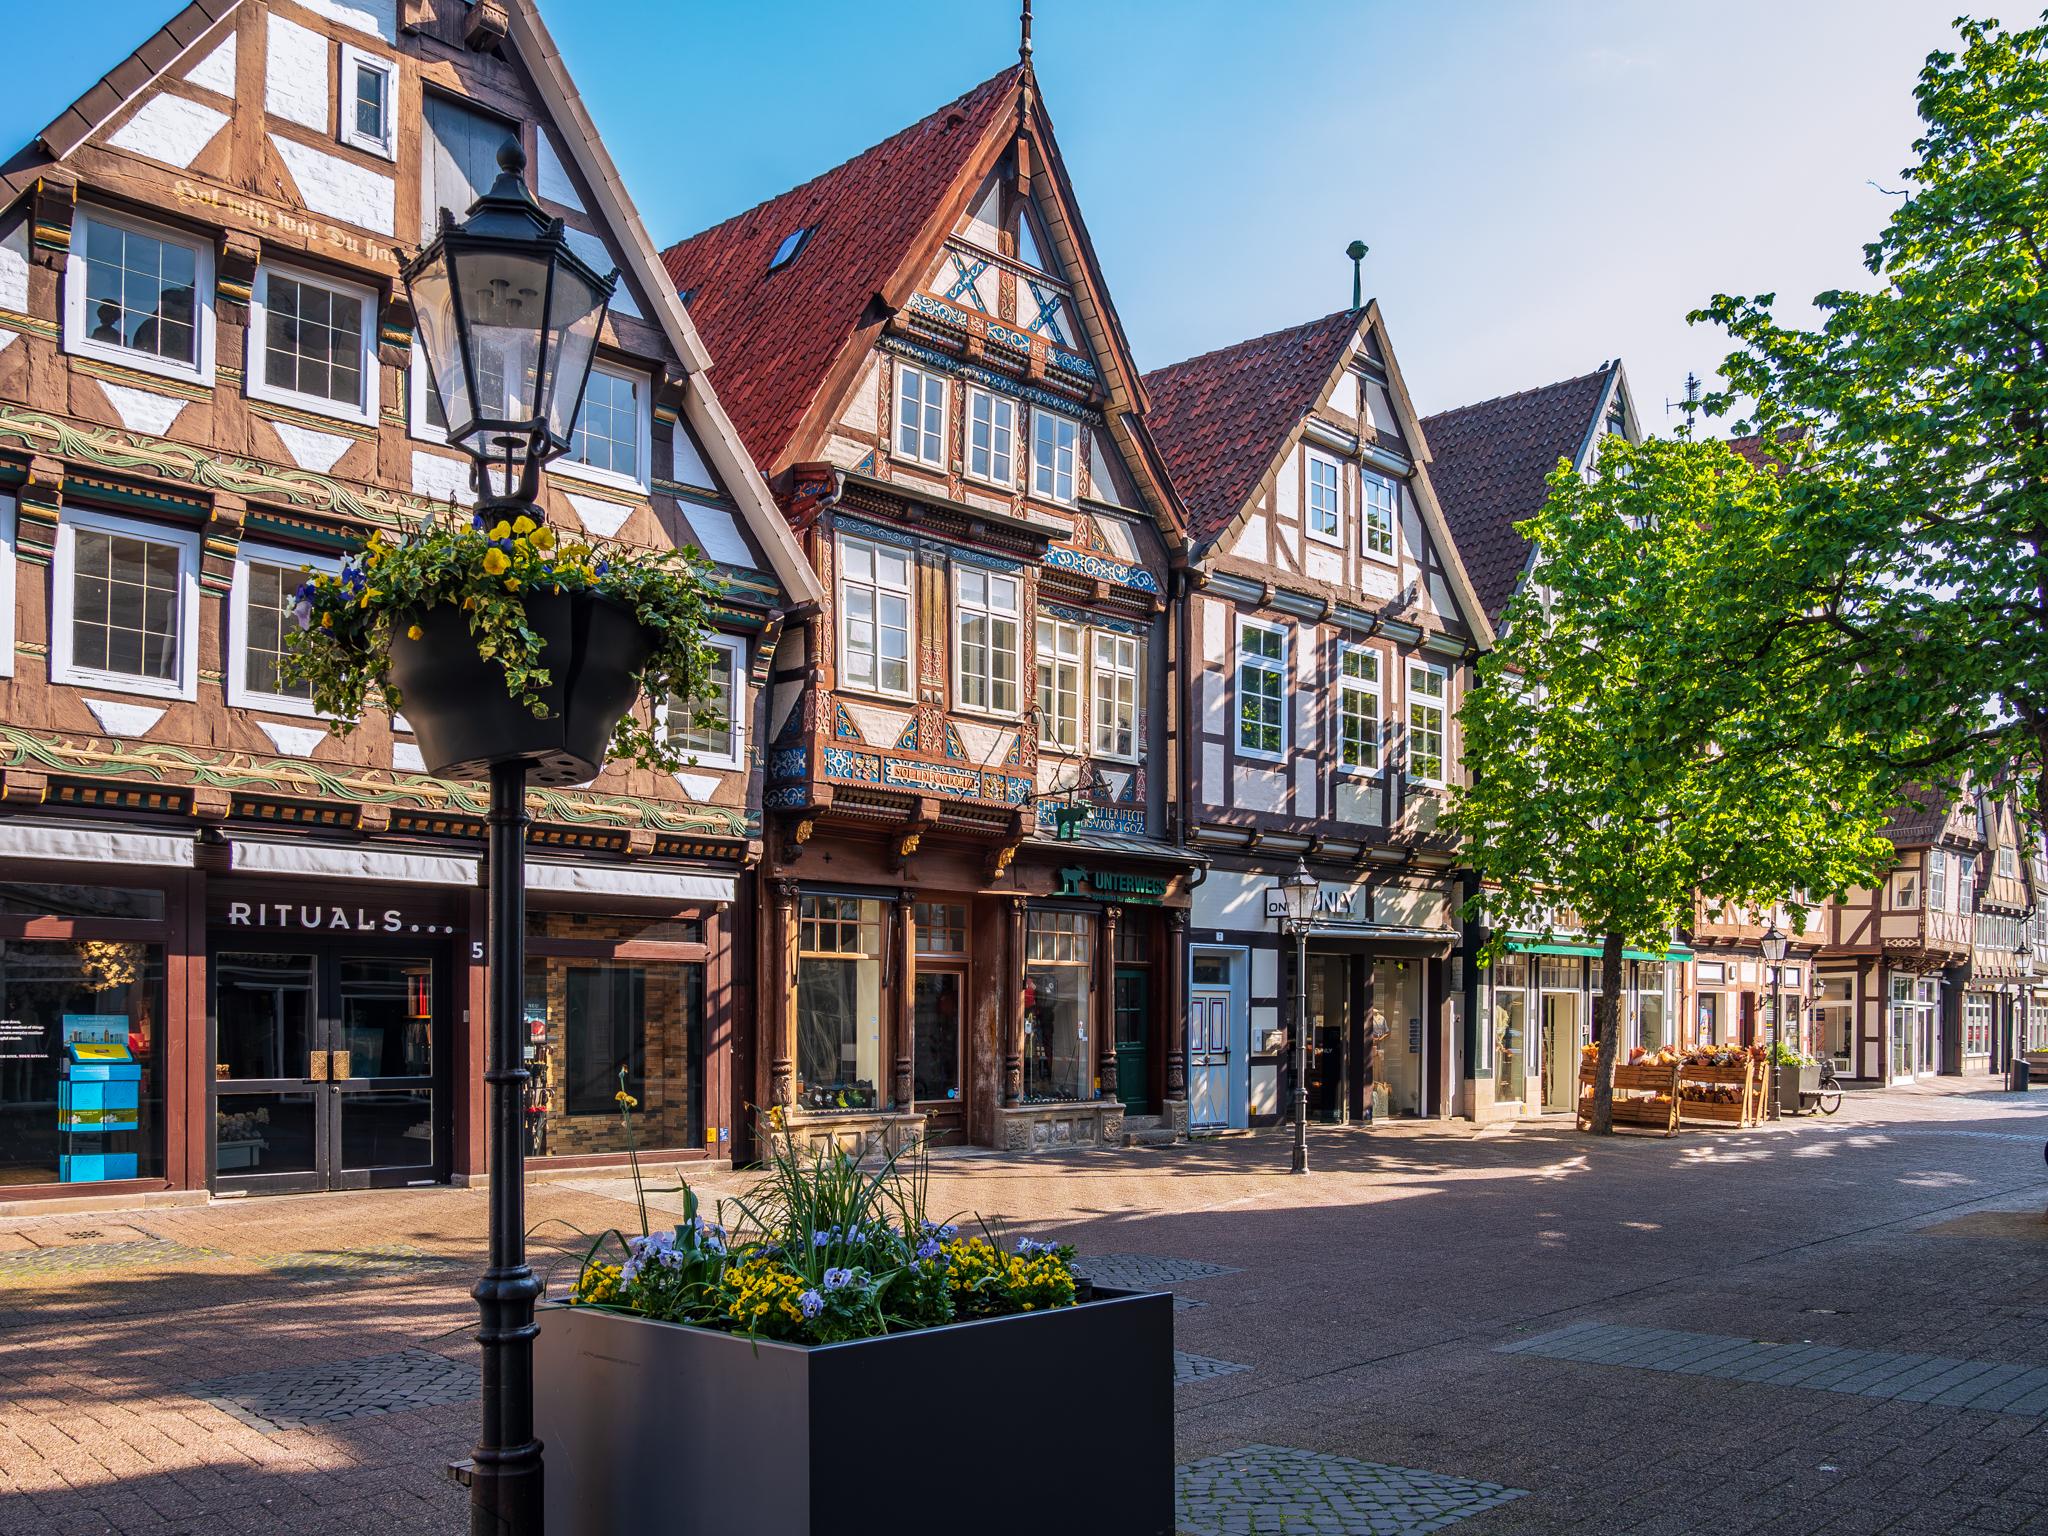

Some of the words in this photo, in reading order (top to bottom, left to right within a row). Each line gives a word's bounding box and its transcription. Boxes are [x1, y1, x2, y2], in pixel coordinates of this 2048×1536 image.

[1096, 871, 1167, 895] UNTERWEGS
[228, 901, 454, 934] RITUALS...
[471, 941, 484, 959] 5
